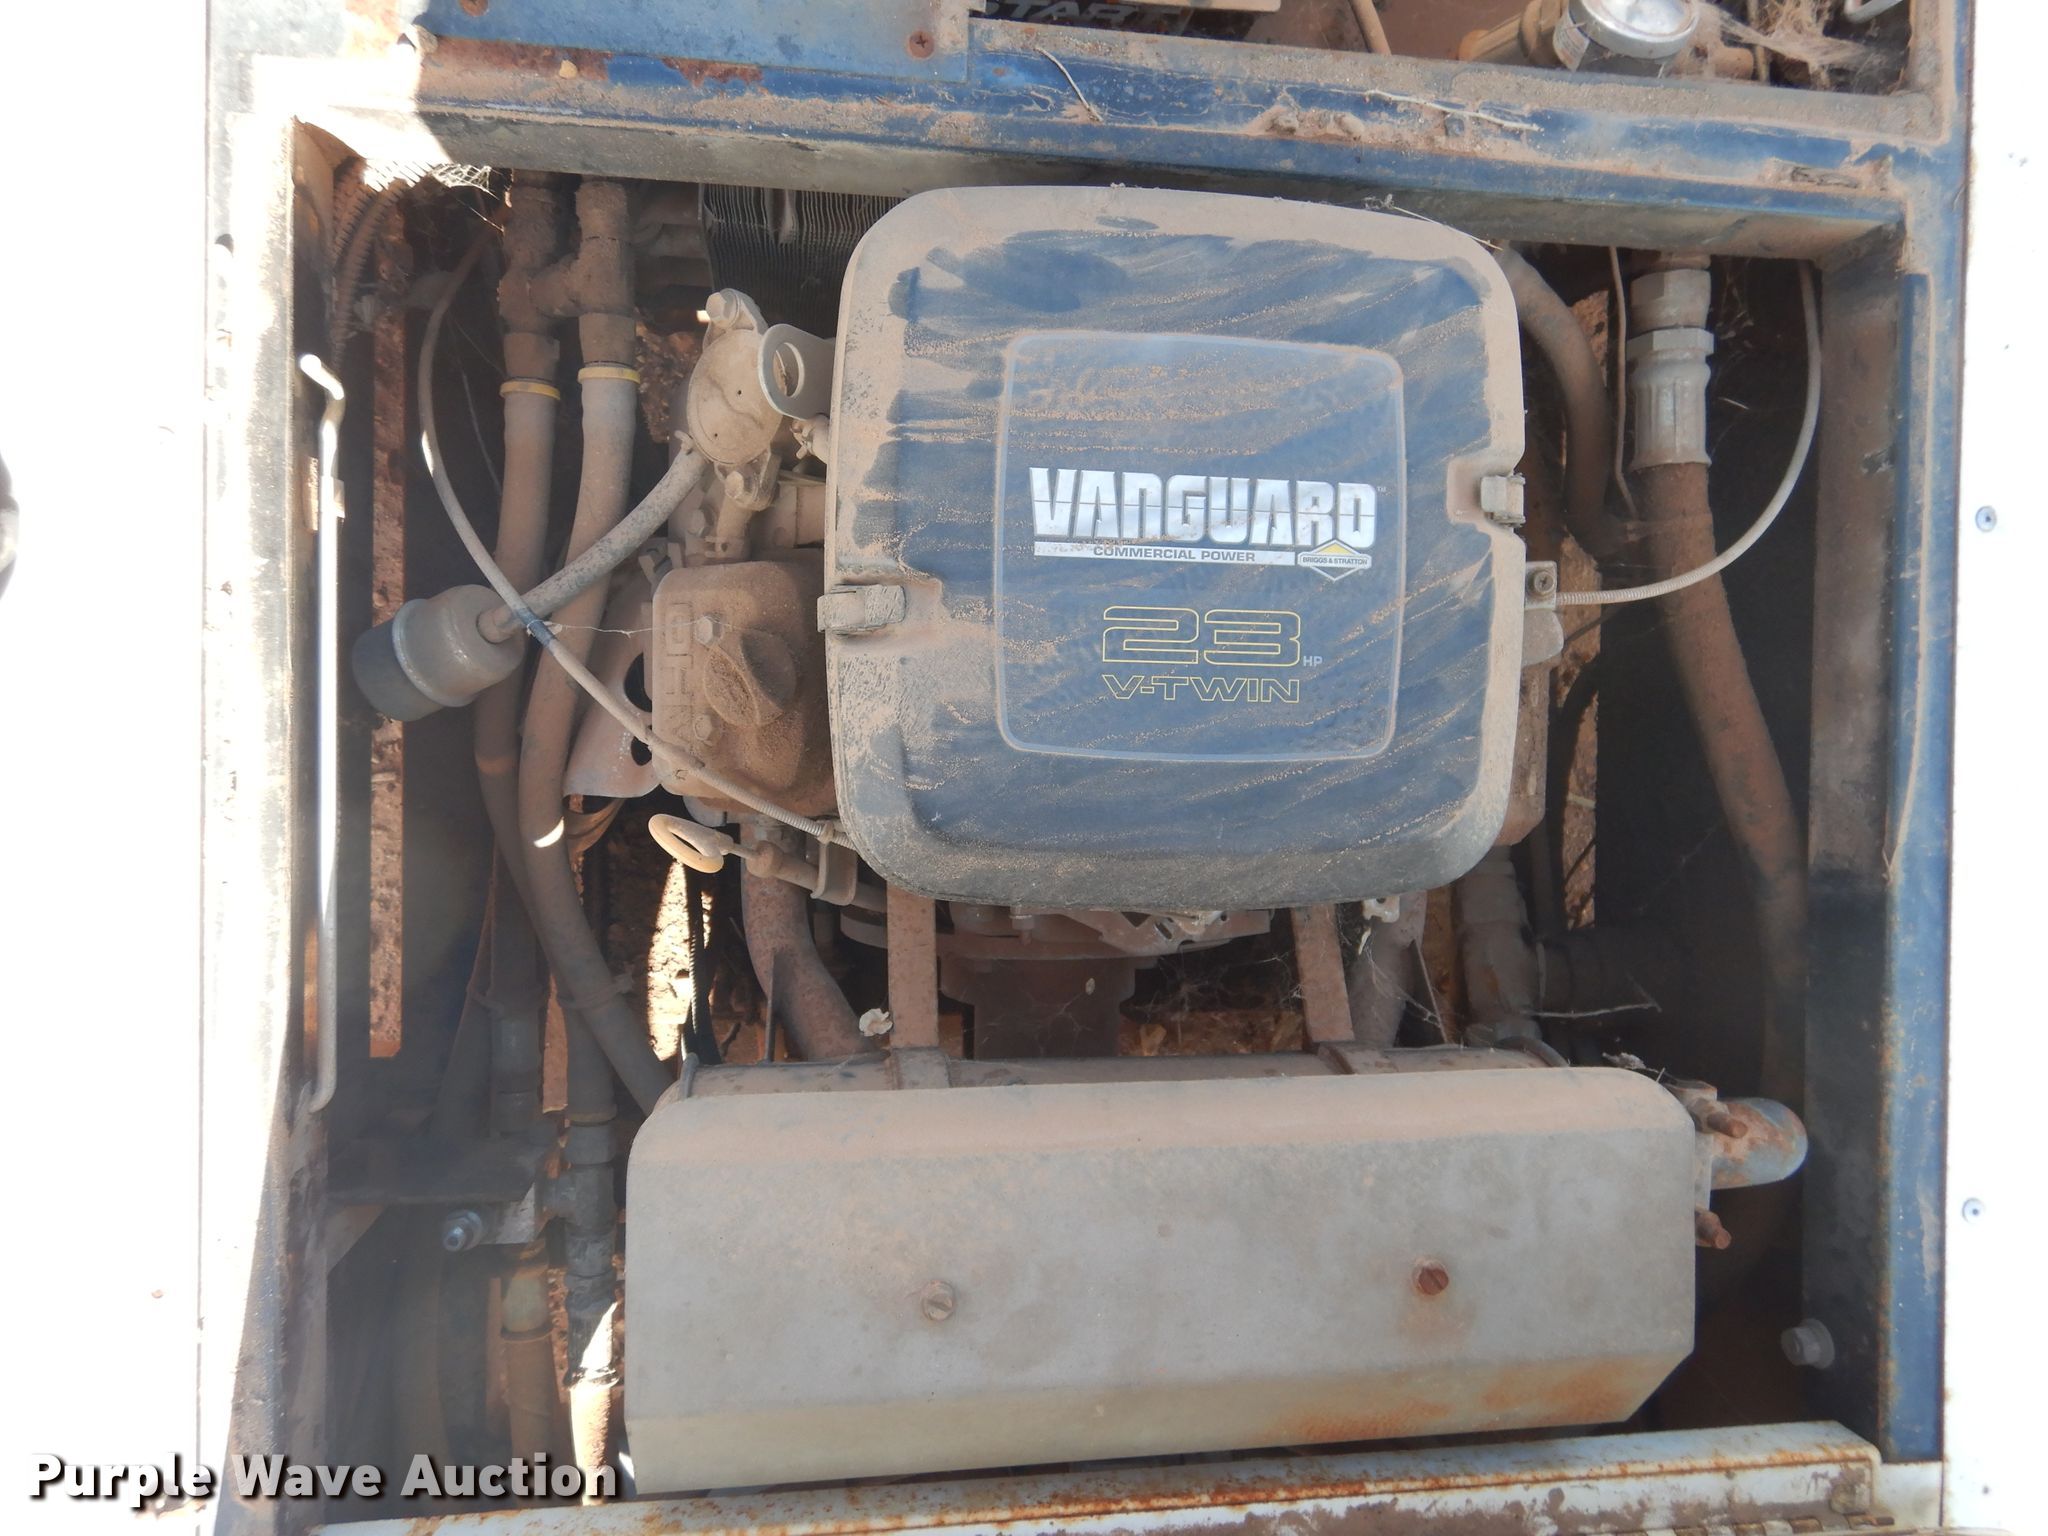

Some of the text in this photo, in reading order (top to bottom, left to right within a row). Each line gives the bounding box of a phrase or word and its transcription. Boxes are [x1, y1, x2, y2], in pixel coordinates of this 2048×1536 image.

[1029, 467, 1377, 549] VANGUARD
[1093, 546, 1256, 562] COMMERCIAL POWER
[1302, 556, 1328, 564] BRIGGS
[1333, 557, 1369, 566] STRATTON
[1102, 605, 1323, 667] 23 HP
[1101, 674, 1300, 703] V-TWIN
